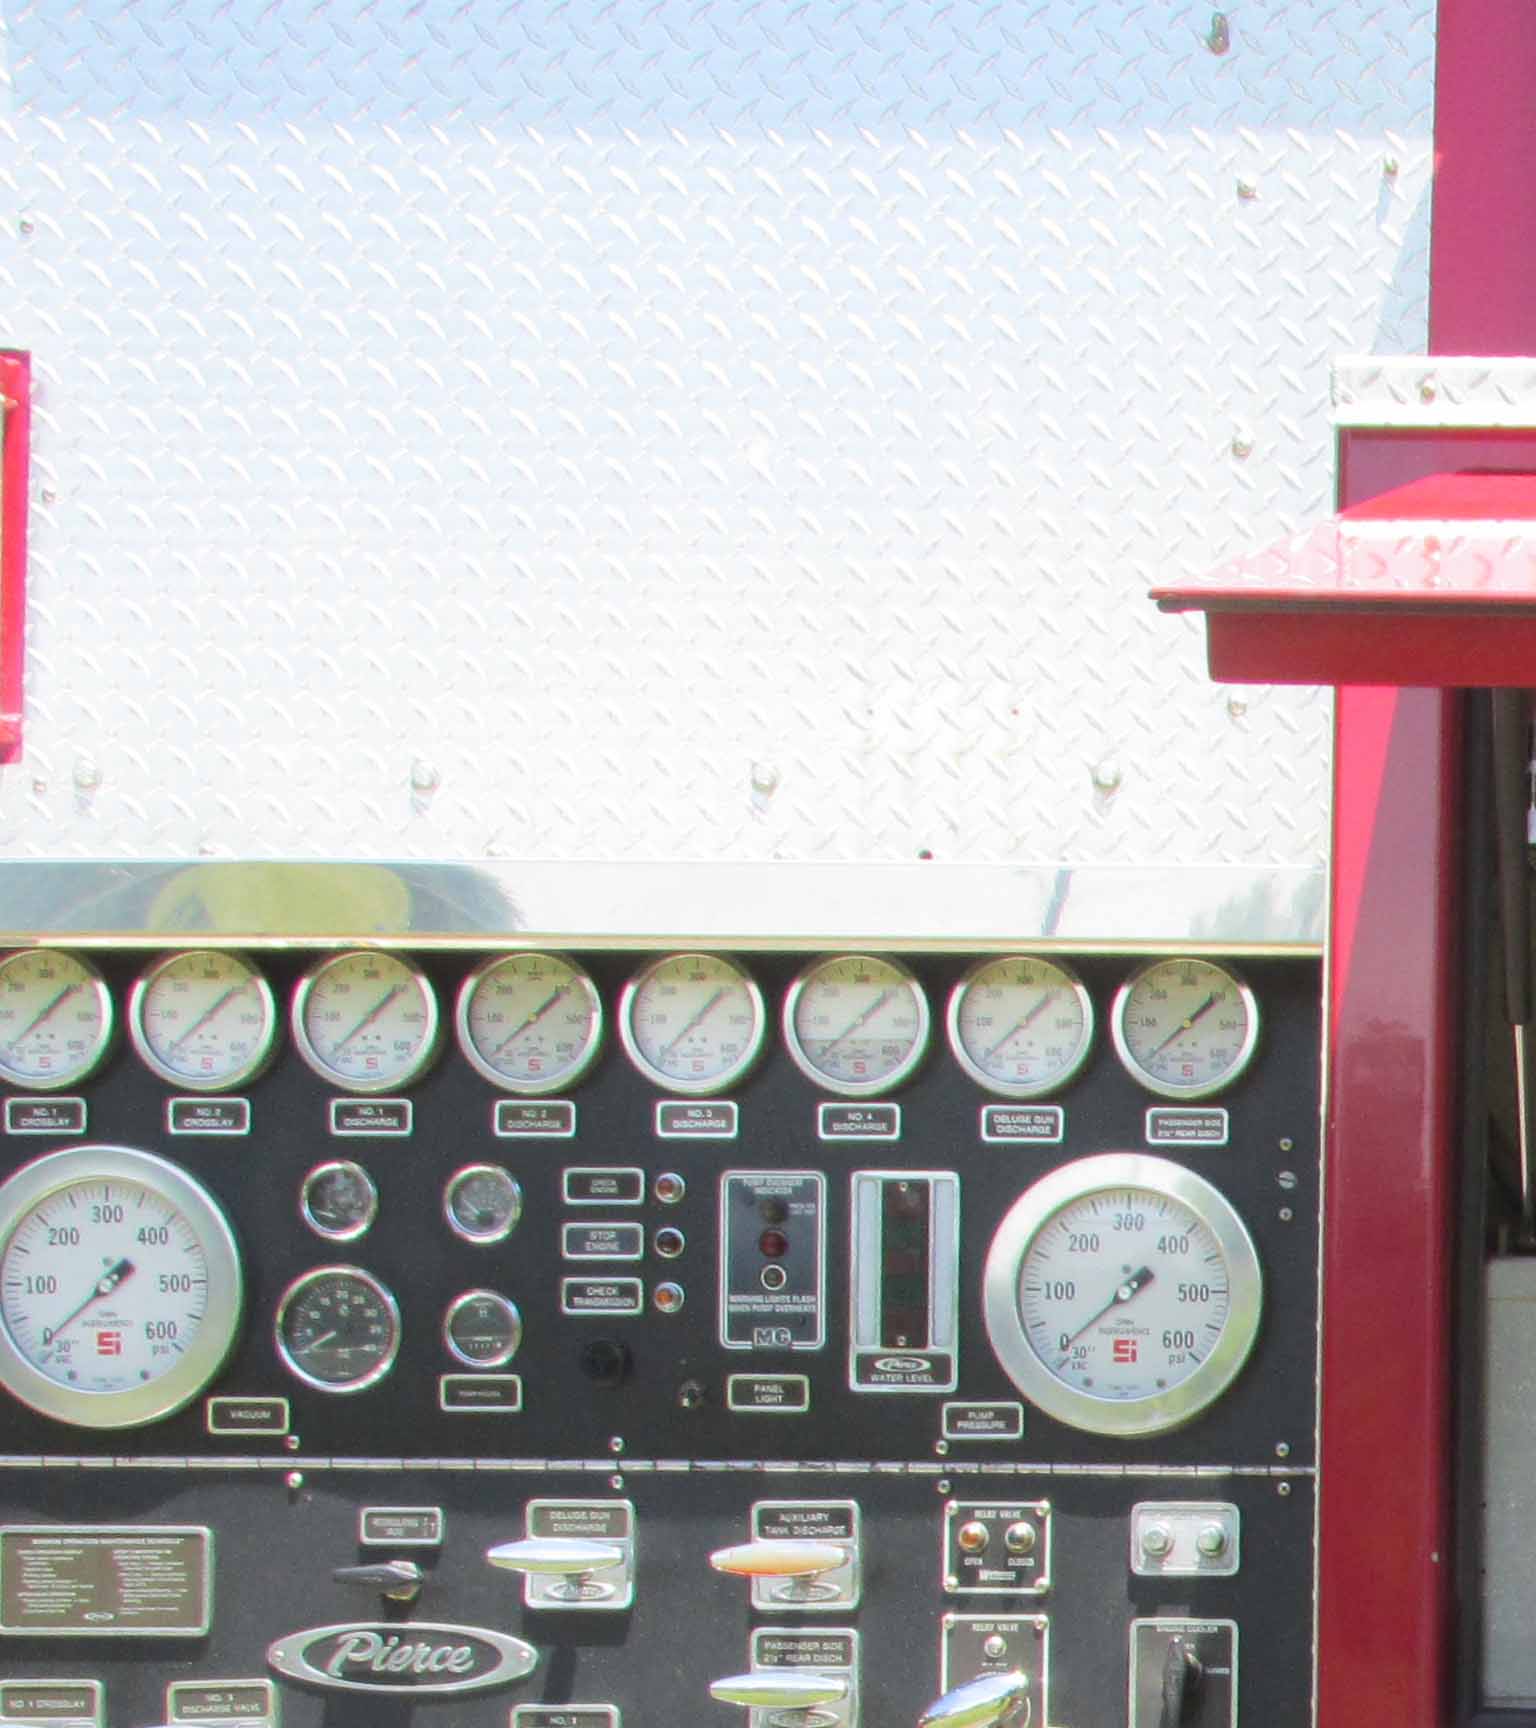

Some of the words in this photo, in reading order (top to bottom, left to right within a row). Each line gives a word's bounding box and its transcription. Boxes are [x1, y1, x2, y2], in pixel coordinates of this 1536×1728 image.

[20, 1118, 70, 1127] CROSSLAY
[184, 1118, 234, 1127] CROSSLAY
[344, 1117, 399, 1128] DISCHARGE
[672, 1119, 727, 1129] DISCHARGE
[993, 1114, 1034, 1124] DELUGE
[1036, 1114, 1054, 1124] GUN
[1158, 1119, 1203, 1127] PASSENGER
[1205, 1119, 1222, 1127] SIDE
[507, 1120, 562, 1130] DISCHARGE
[833, 1122, 888, 1132] DISCHARGE
[996, 1125, 1051, 1135] DISCHARGE
[92, 1205, 124, 1223] 300
[1113, 1213, 1144, 1231] 300
[48, 1228, 80, 1245] 200
[137, 1227, 169, 1245] 400
[589, 1231, 616, 1240] STOP
[585, 1241, 620, 1251] ENGINE
[1068, 1234, 1100, 1253] 200
[1157, 1236, 1189, 1254] 400
[26, 1276, 57, 1294] 100
[159, 1275, 191, 1292] 500
[587, 1286, 618, 1296] CHECK
[1044, 1281, 1075, 1300] 100
[1178, 1283, 1209, 1302] 500
[574, 1297, 635, 1307] TRANSMISSION
[791, 1295, 816, 1303] FLASH
[145, 1321, 177, 1339] 600
[43, 1327, 52, 1345] 0
[1162, 1331, 1194, 1349] 600
[1060, 1335, 1069, 1352] 0
[1168, 1354, 1186, 1368] psi
[870, 1374, 904, 1382] WATER
[905, 1374, 935, 1383] LEVEL
[754, 1385, 784, 1394] PANEL
[755, 1394, 783, 1403] LIGHT
[230, 1409, 271, 1419] VACUUM
[968, 1411, 994, 1420] PUMP
[957, 1421, 1006, 1430] PRESSURE
[550, 1511, 588, 1520] DELUGE
[589, 1511, 610, 1520] GUN
[779, 1513, 830, 1522] AUXILIARY
[1000, 1510, 1022, 1519] VALVE
[552, 1523, 607, 1532] DISCHARGE
[764, 1525, 789, 1535] TANK
[793, 1525, 846, 1535] DISCHARGE
[997, 1624, 1019, 1632] VALVE
[764, 1641, 820, 1650] PASSENGER
[822, 1641, 844, 1650] SIDE
[326, 1631, 475, 1678] Pierce
[785, 1653, 812, 1663] REAR
[183, 1705, 231, 1713] DISCHARGE
[235, 1703, 260, 1712] VALVE
